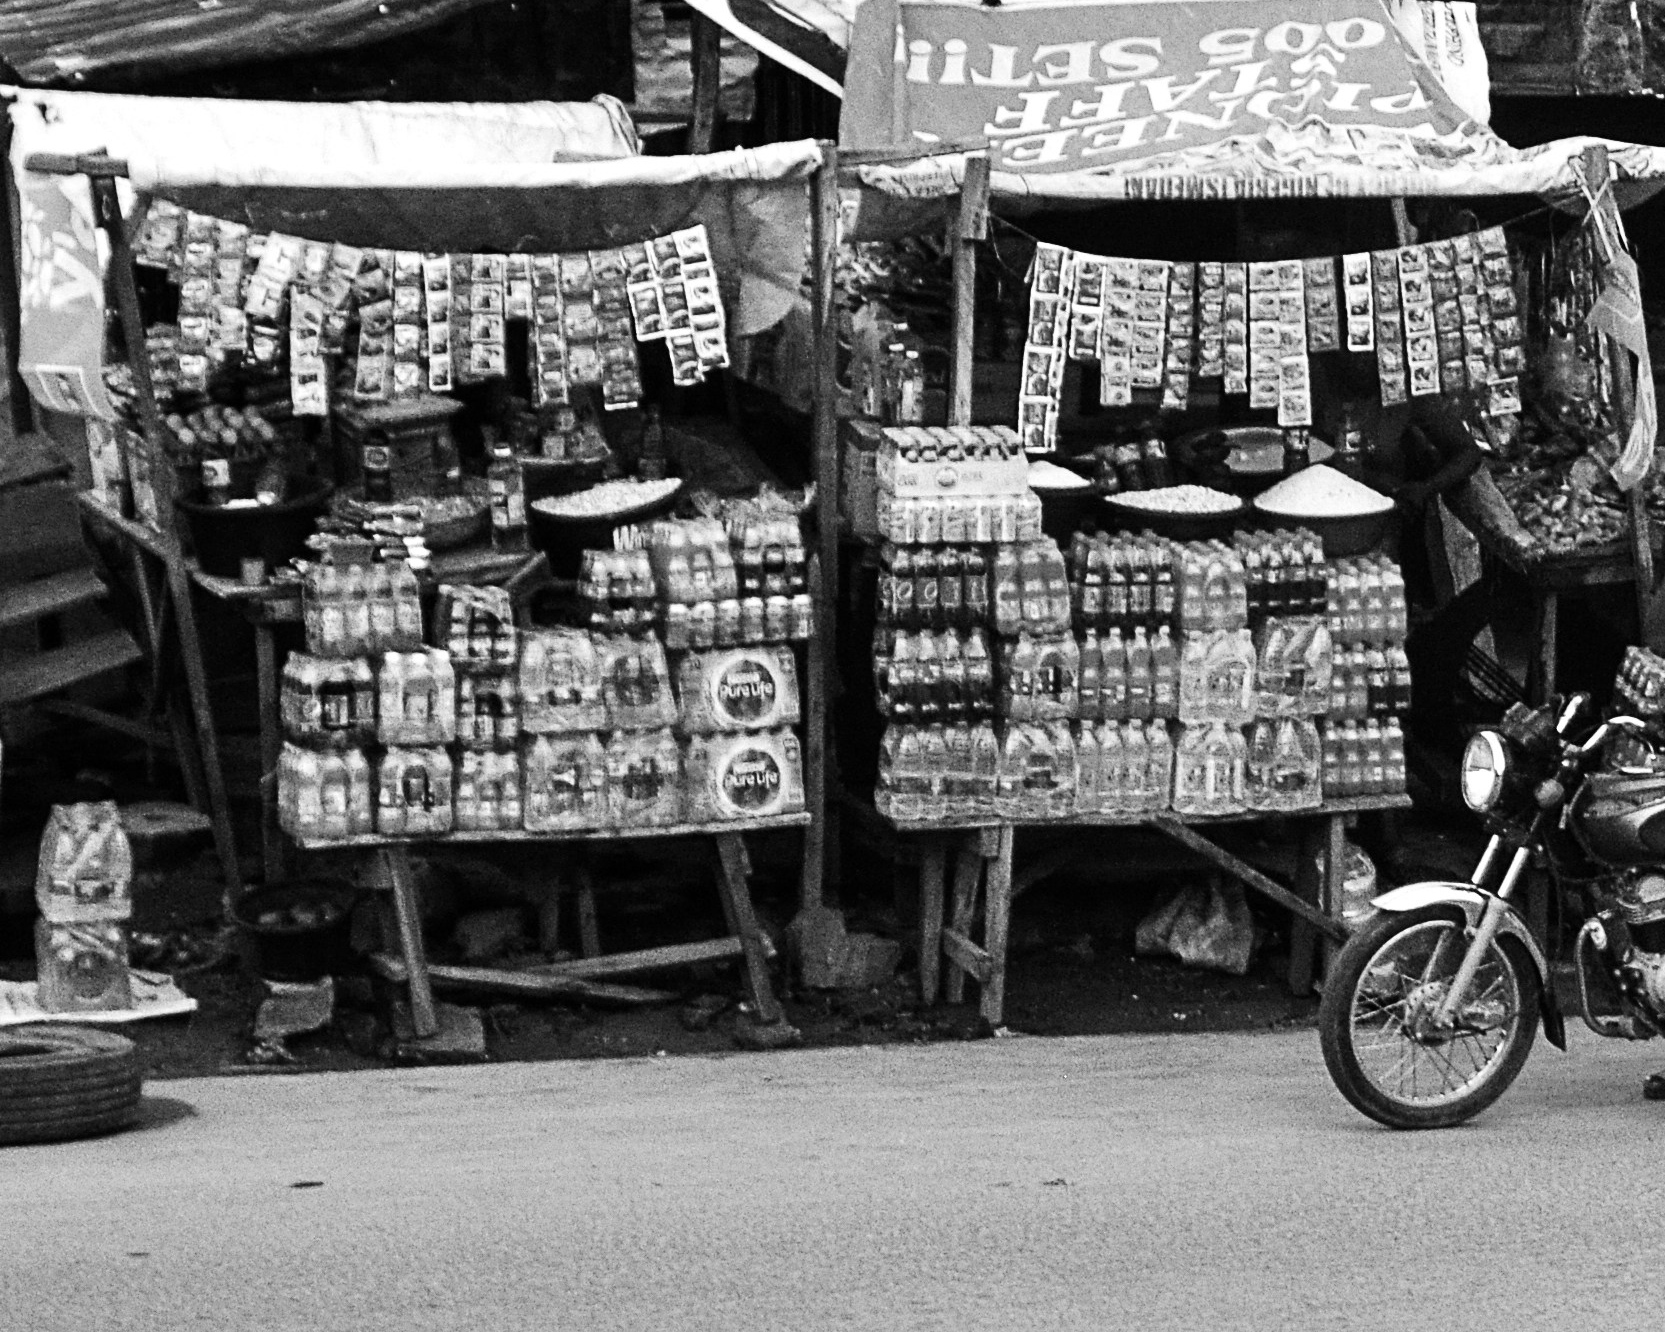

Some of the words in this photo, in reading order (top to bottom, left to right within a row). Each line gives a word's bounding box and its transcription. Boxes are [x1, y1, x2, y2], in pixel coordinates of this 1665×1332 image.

[990, 79, 1433, 166] PIONEE
[720, 682, 750, 698] Pure
[750, 680, 774, 699] Life
[724, 772, 755, 788] Pure
[756, 769, 779, 789] Life
